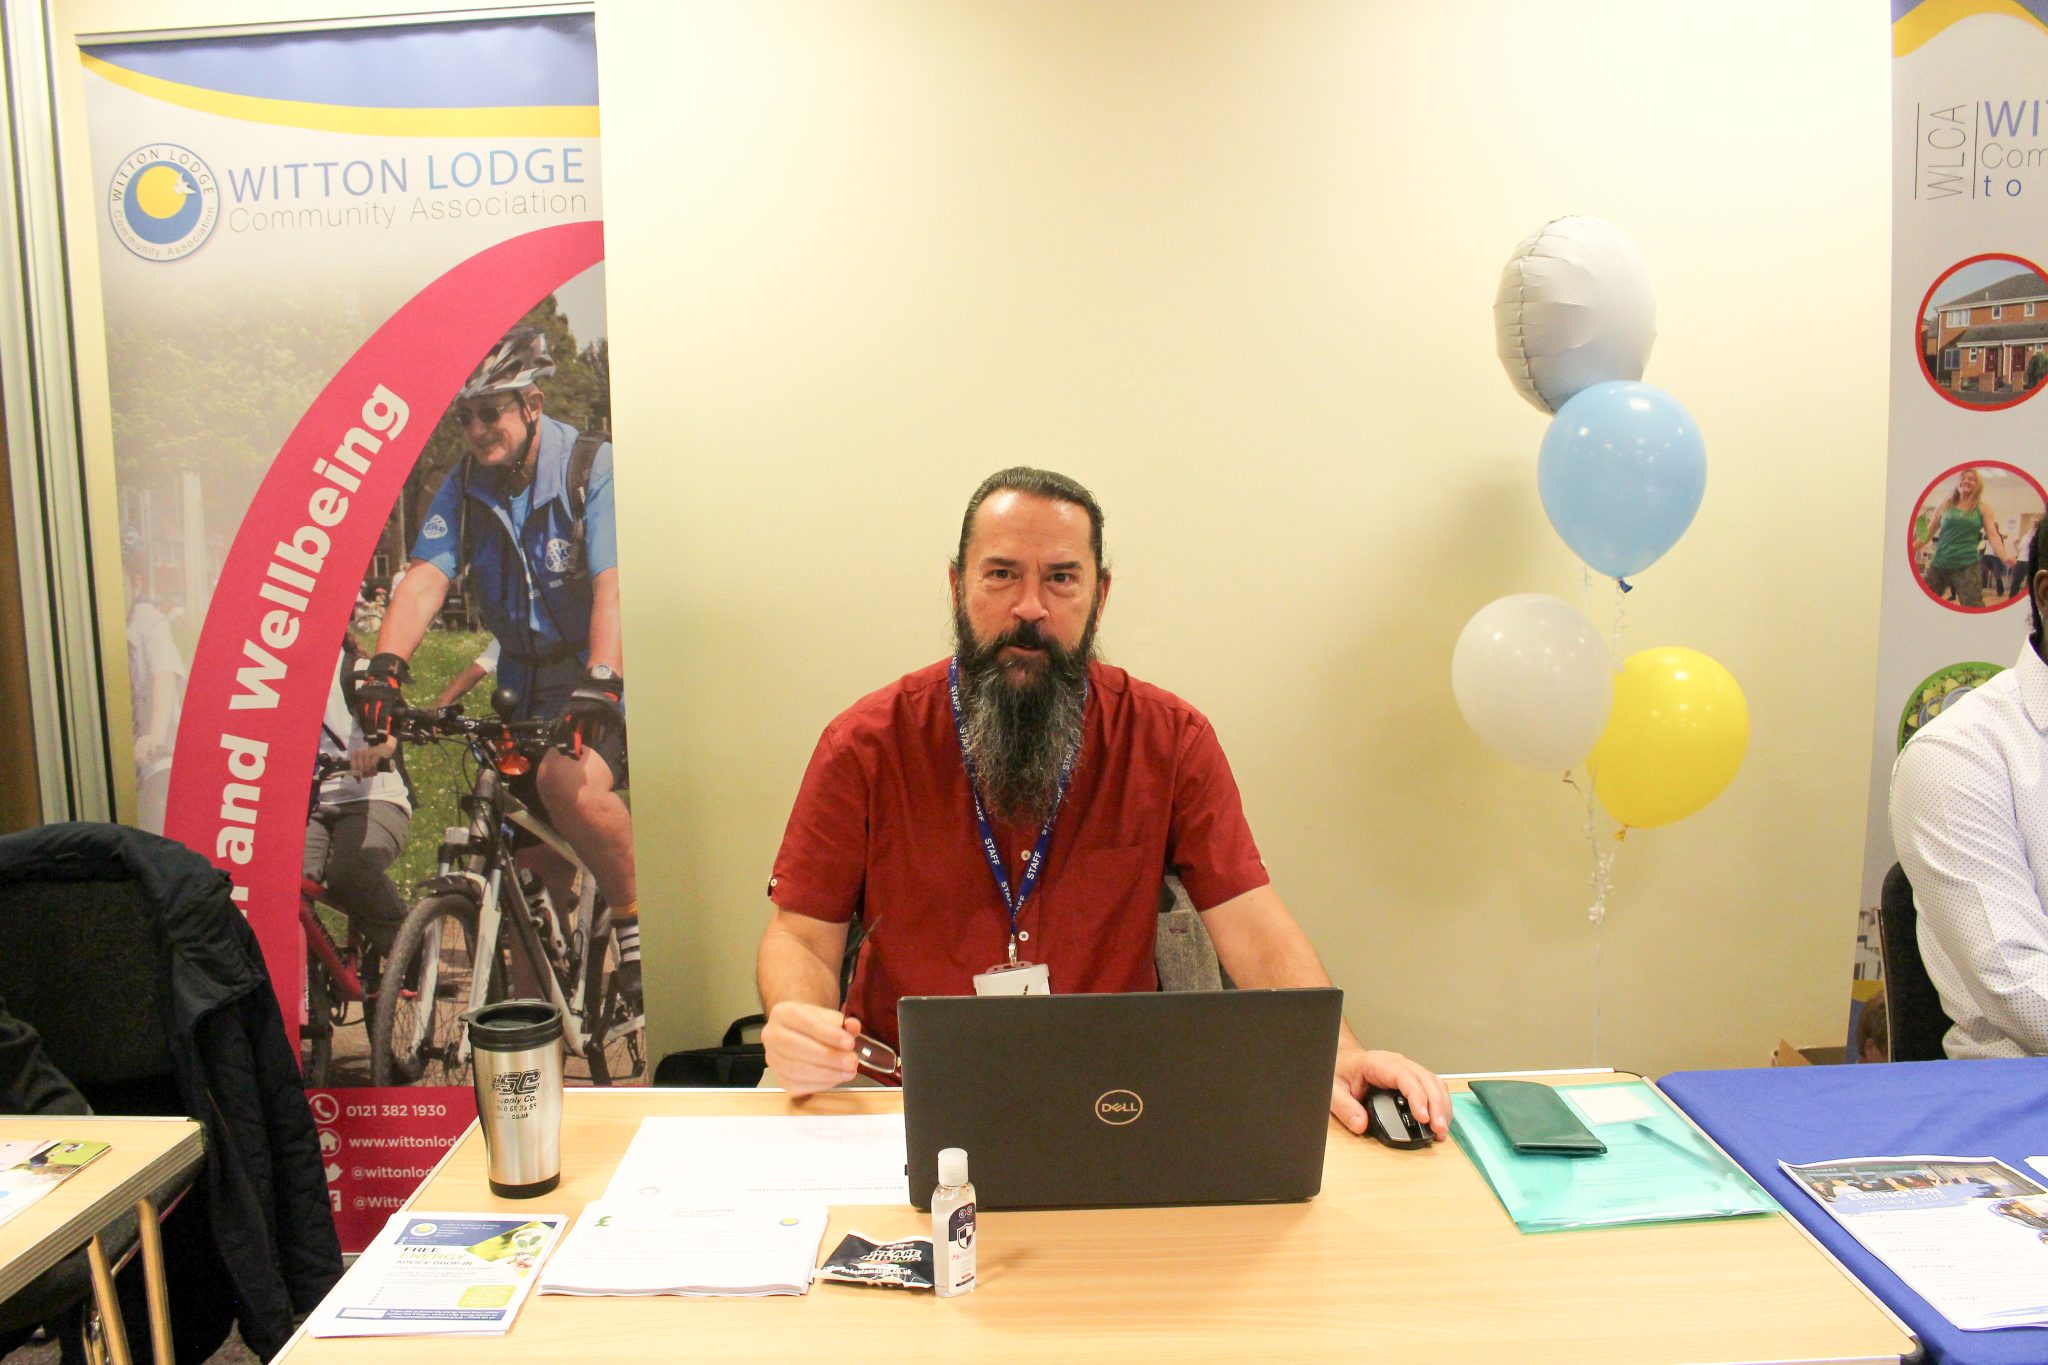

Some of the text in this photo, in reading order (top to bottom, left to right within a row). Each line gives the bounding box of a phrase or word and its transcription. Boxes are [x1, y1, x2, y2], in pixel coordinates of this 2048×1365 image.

[1984, 100, 2048, 137] WI
[1928, 104, 1967, 200] WLCA
[112, 148, 215, 202] WITTON LODGE
[228, 147, 584, 203] WITTON LODGE
[1983, 175, 2021, 197] to
[229, 188, 587, 233] Community Association
[113, 206, 214, 257] Community Association
[216, 383, 409, 865] and Wellbeing
[951, 685, 962, 712] STAFF
[985, 838, 1001, 865] STAFF
[1026, 851, 1042, 880] STAFF
[346, 1104, 447, 1117] 0121 382 1930
[1101, 1102, 1138, 1112] DELL
[1846, 1188, 1942, 1201] ERDINGTON
[400, 1252, 466, 1260] ENERGY
